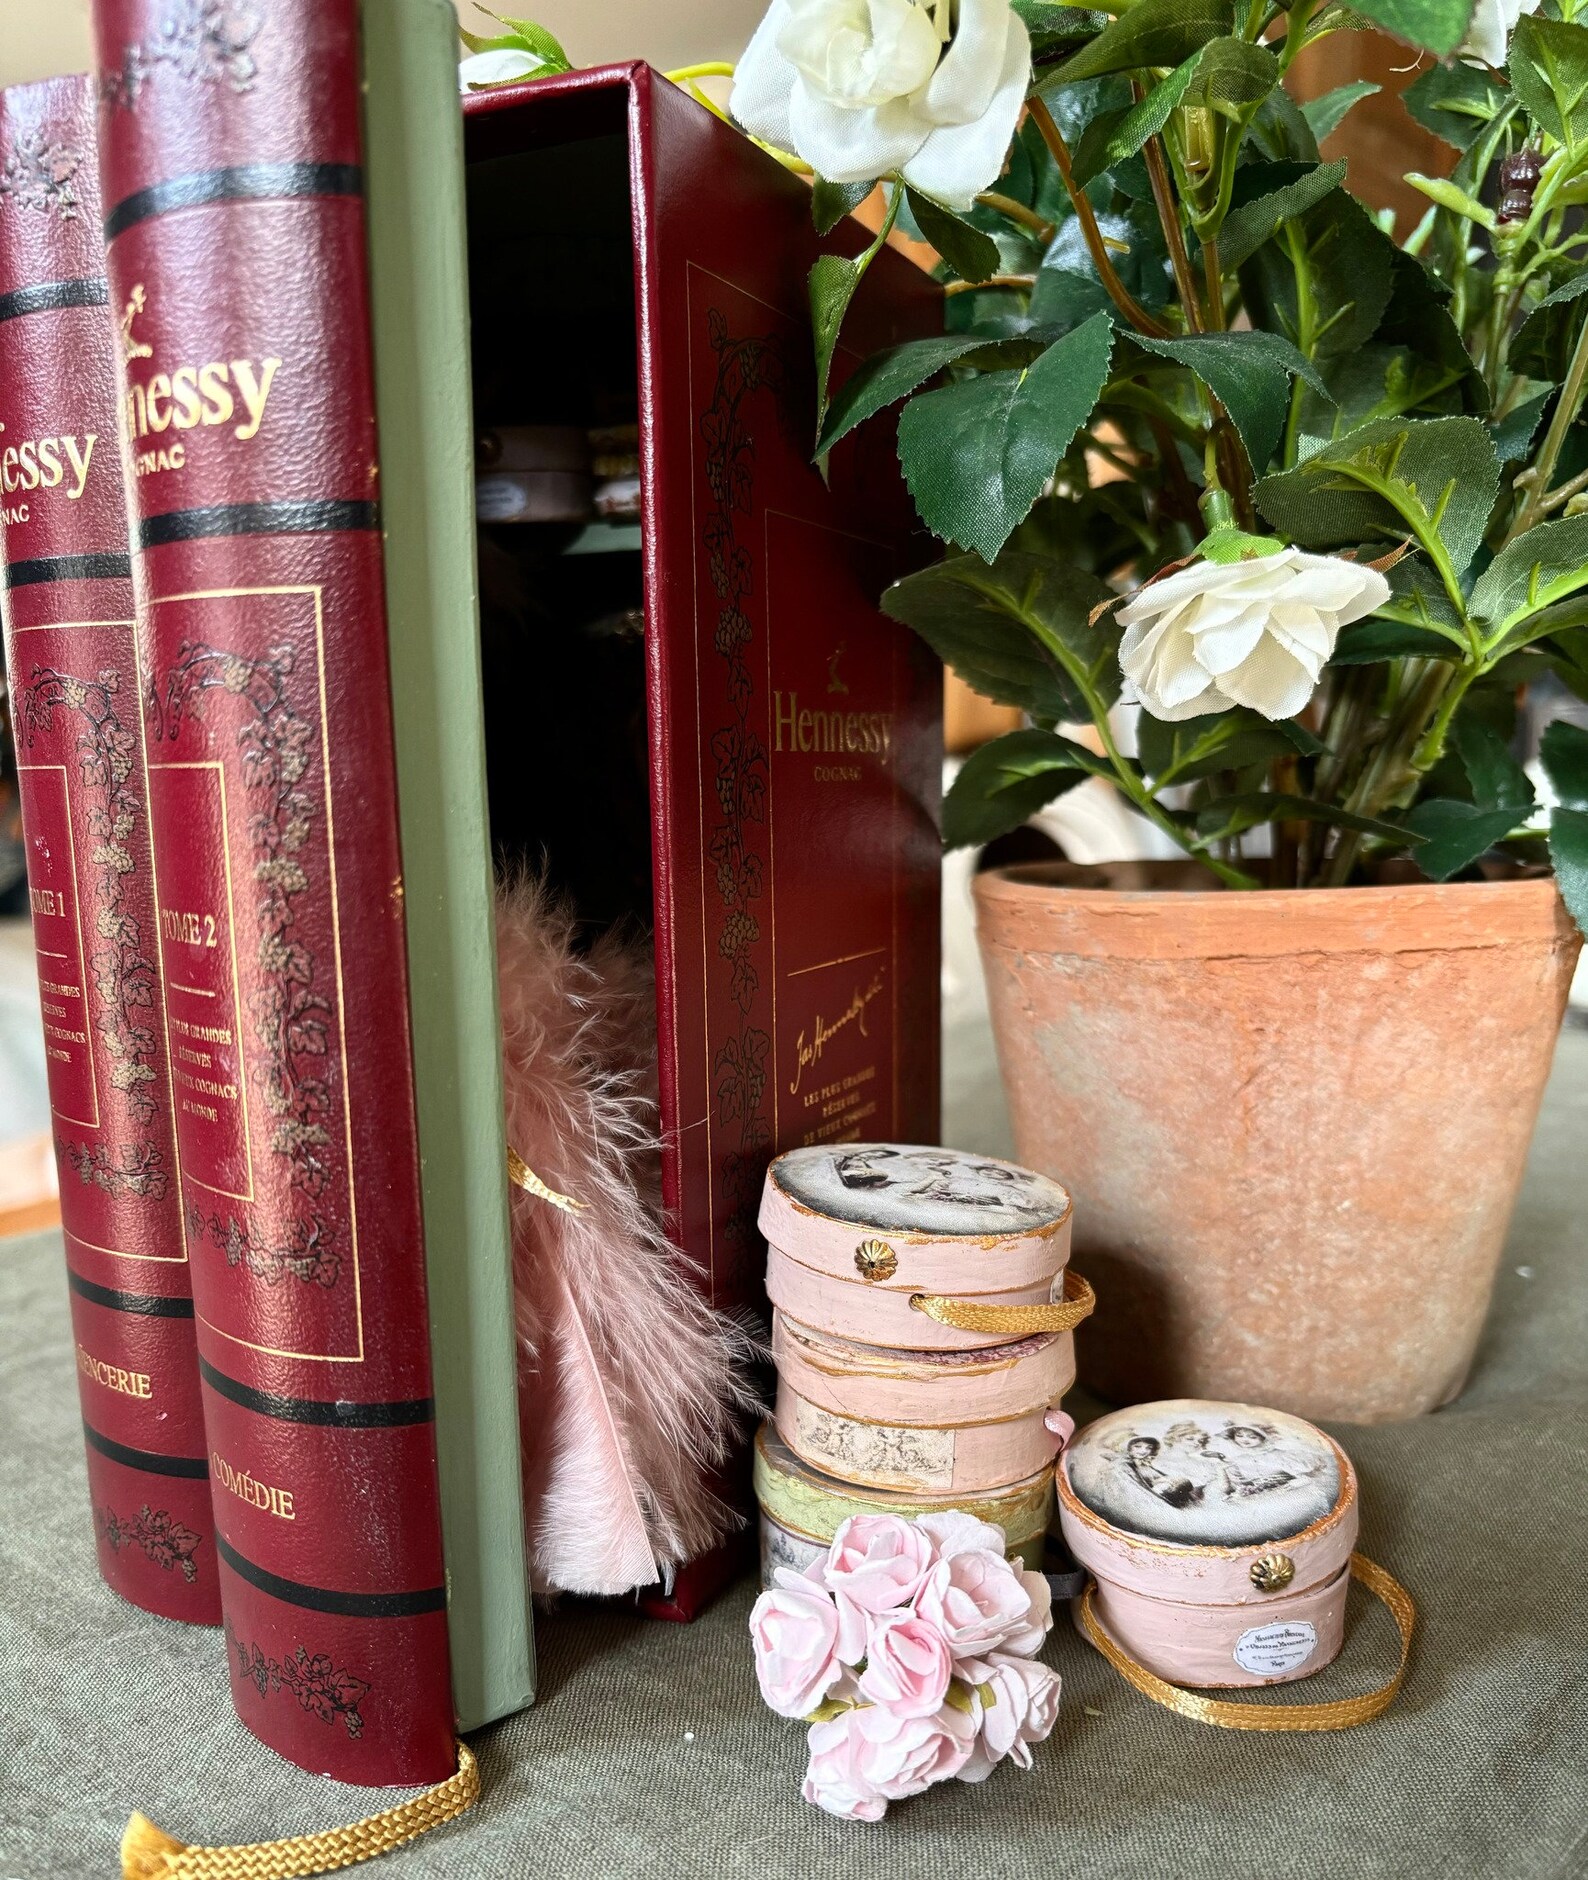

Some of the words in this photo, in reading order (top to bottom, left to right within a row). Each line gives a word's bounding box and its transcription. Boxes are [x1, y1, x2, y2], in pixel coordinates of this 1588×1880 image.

[0, 433, 99, 500] essy
[772, 690, 894, 766] Hennessy
[813, 765, 863, 783] COGNAC
[57, 891, 67, 917] 1
[160, 908, 202, 946] TOME
[204, 914, 218, 948] 2
[190, 1023, 232, 1045] GRANDES
[195, 1077, 238, 1100] COGNACS
[213, 1451, 296, 1520] COMÉDIE
